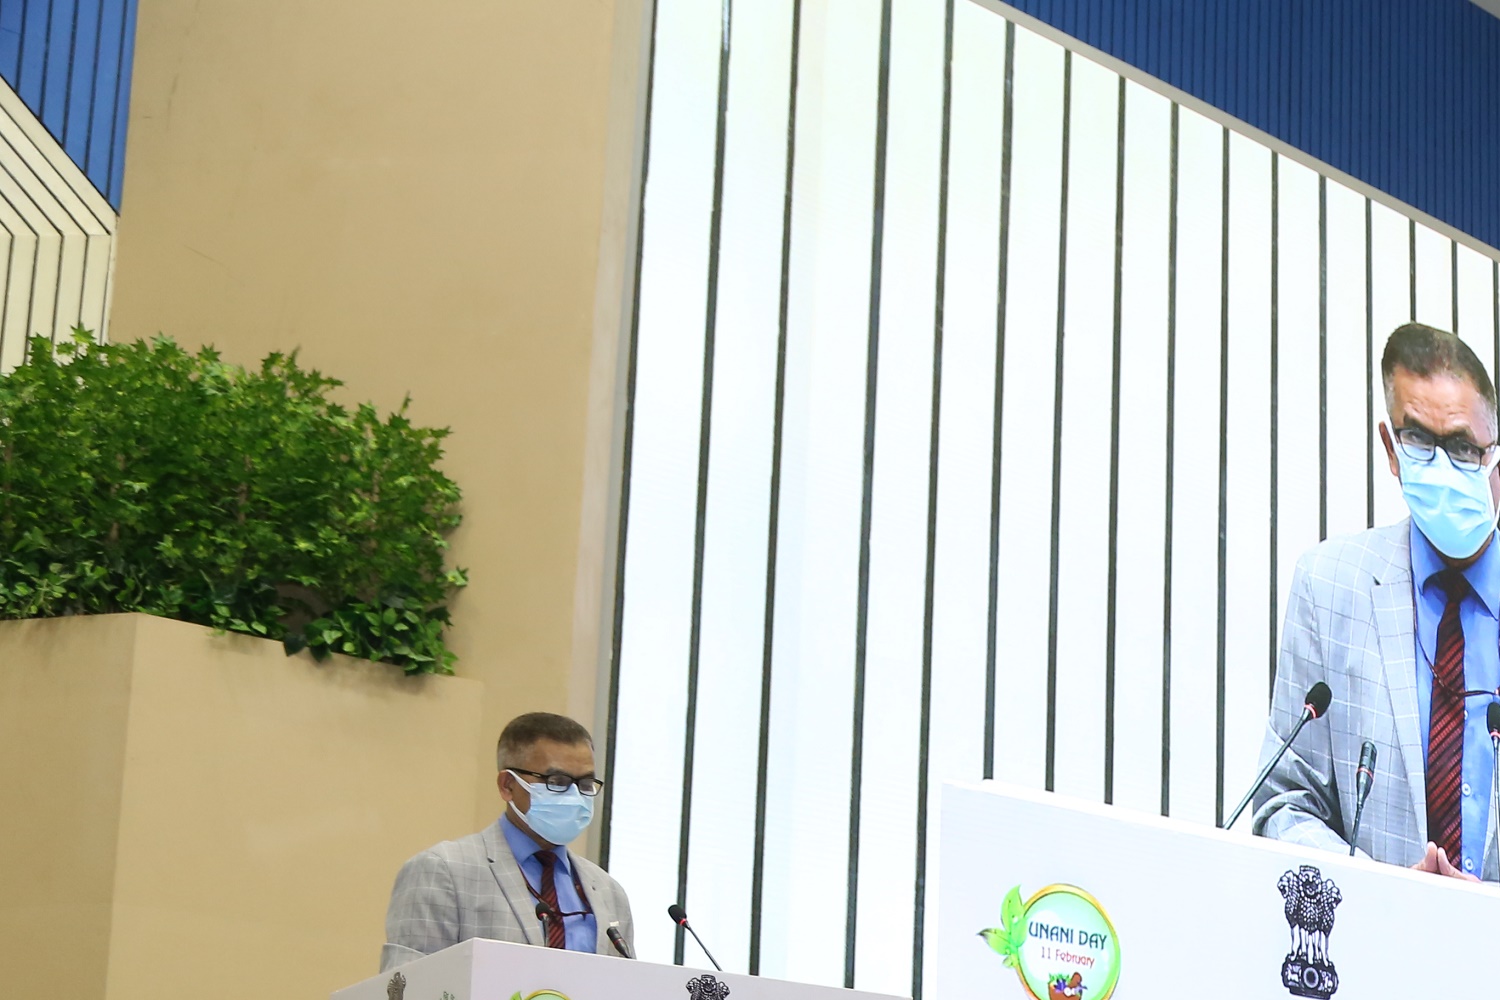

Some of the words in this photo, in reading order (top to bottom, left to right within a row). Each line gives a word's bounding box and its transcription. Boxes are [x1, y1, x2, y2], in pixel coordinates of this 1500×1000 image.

[1028, 921, 1074, 944] UNANI
[1079, 930, 1107, 950] DAY
[1042, 946, 1050, 960] 11
[1055, 948, 1095, 969] February
